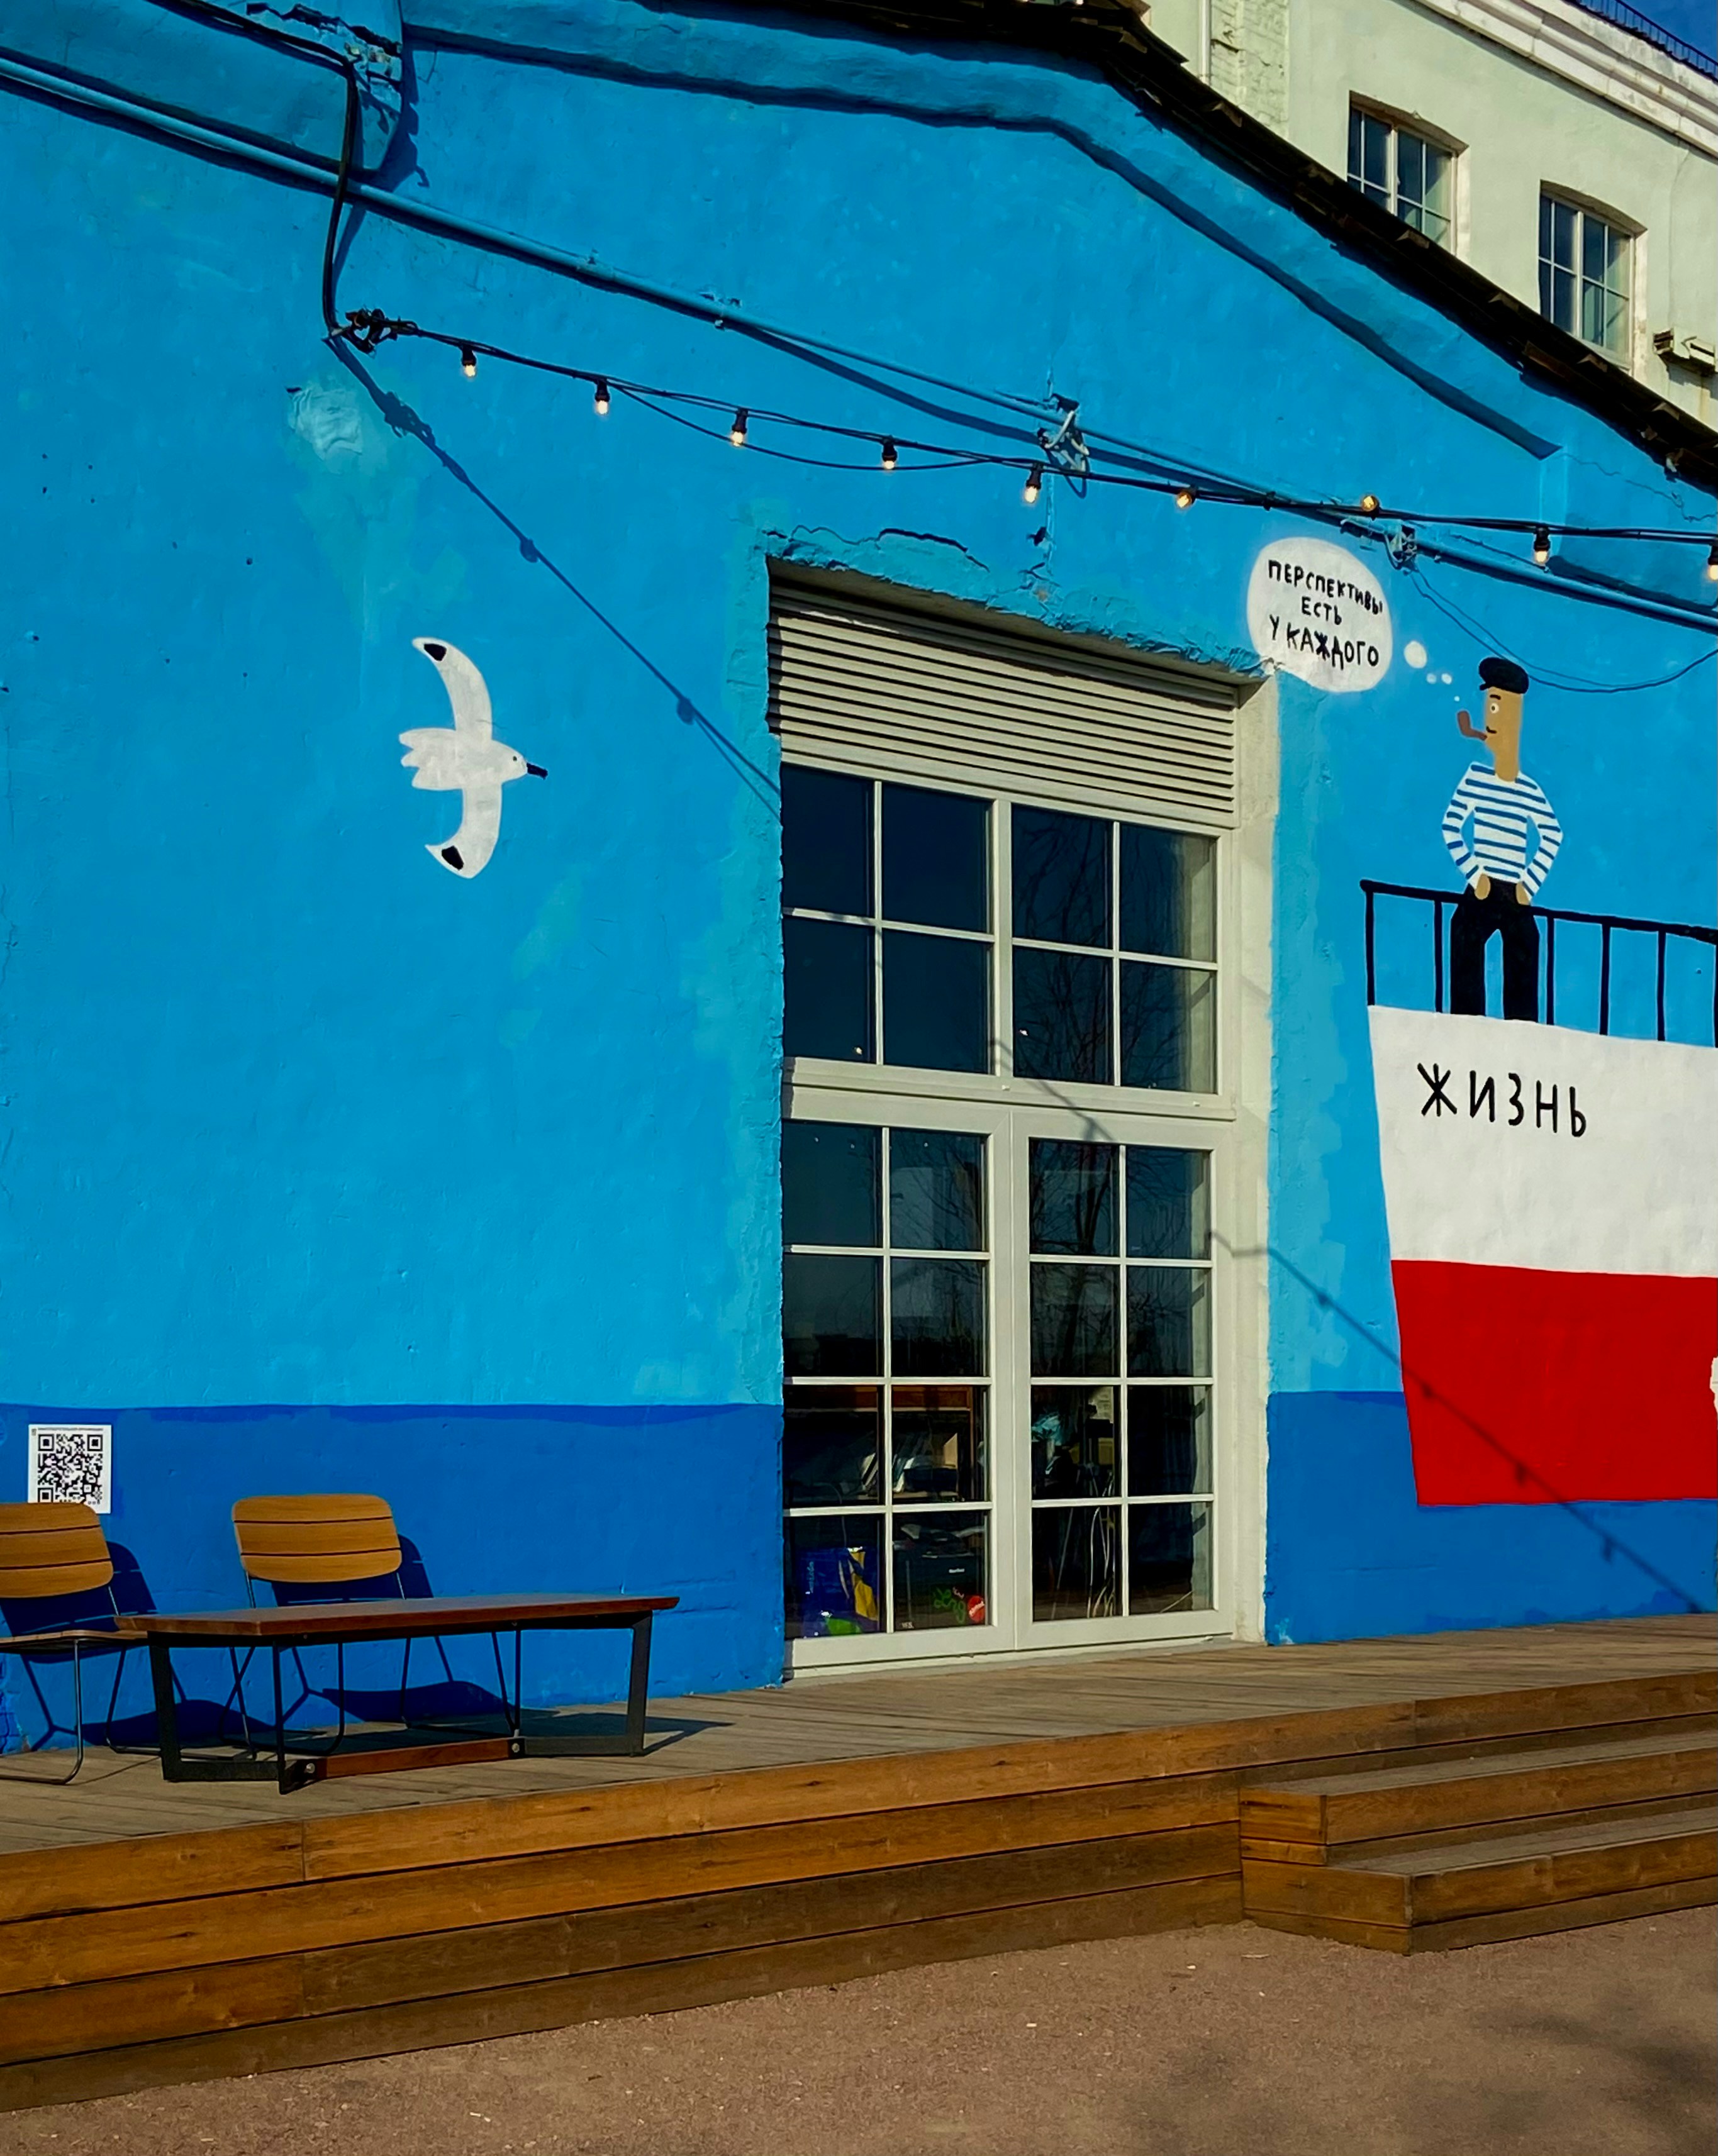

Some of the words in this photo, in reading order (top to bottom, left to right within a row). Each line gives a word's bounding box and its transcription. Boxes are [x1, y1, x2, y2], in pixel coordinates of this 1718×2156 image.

[1268, 560, 1383, 614] ПЕРСПЕКТИВЫ
[1302, 596, 1342, 625] ЕСТЬ
[1269, 614, 1280, 640] У
[1286, 623, 1379, 670] КАЖДОГО
[1417, 1063, 1586, 1137] ЖИЗНЬ
